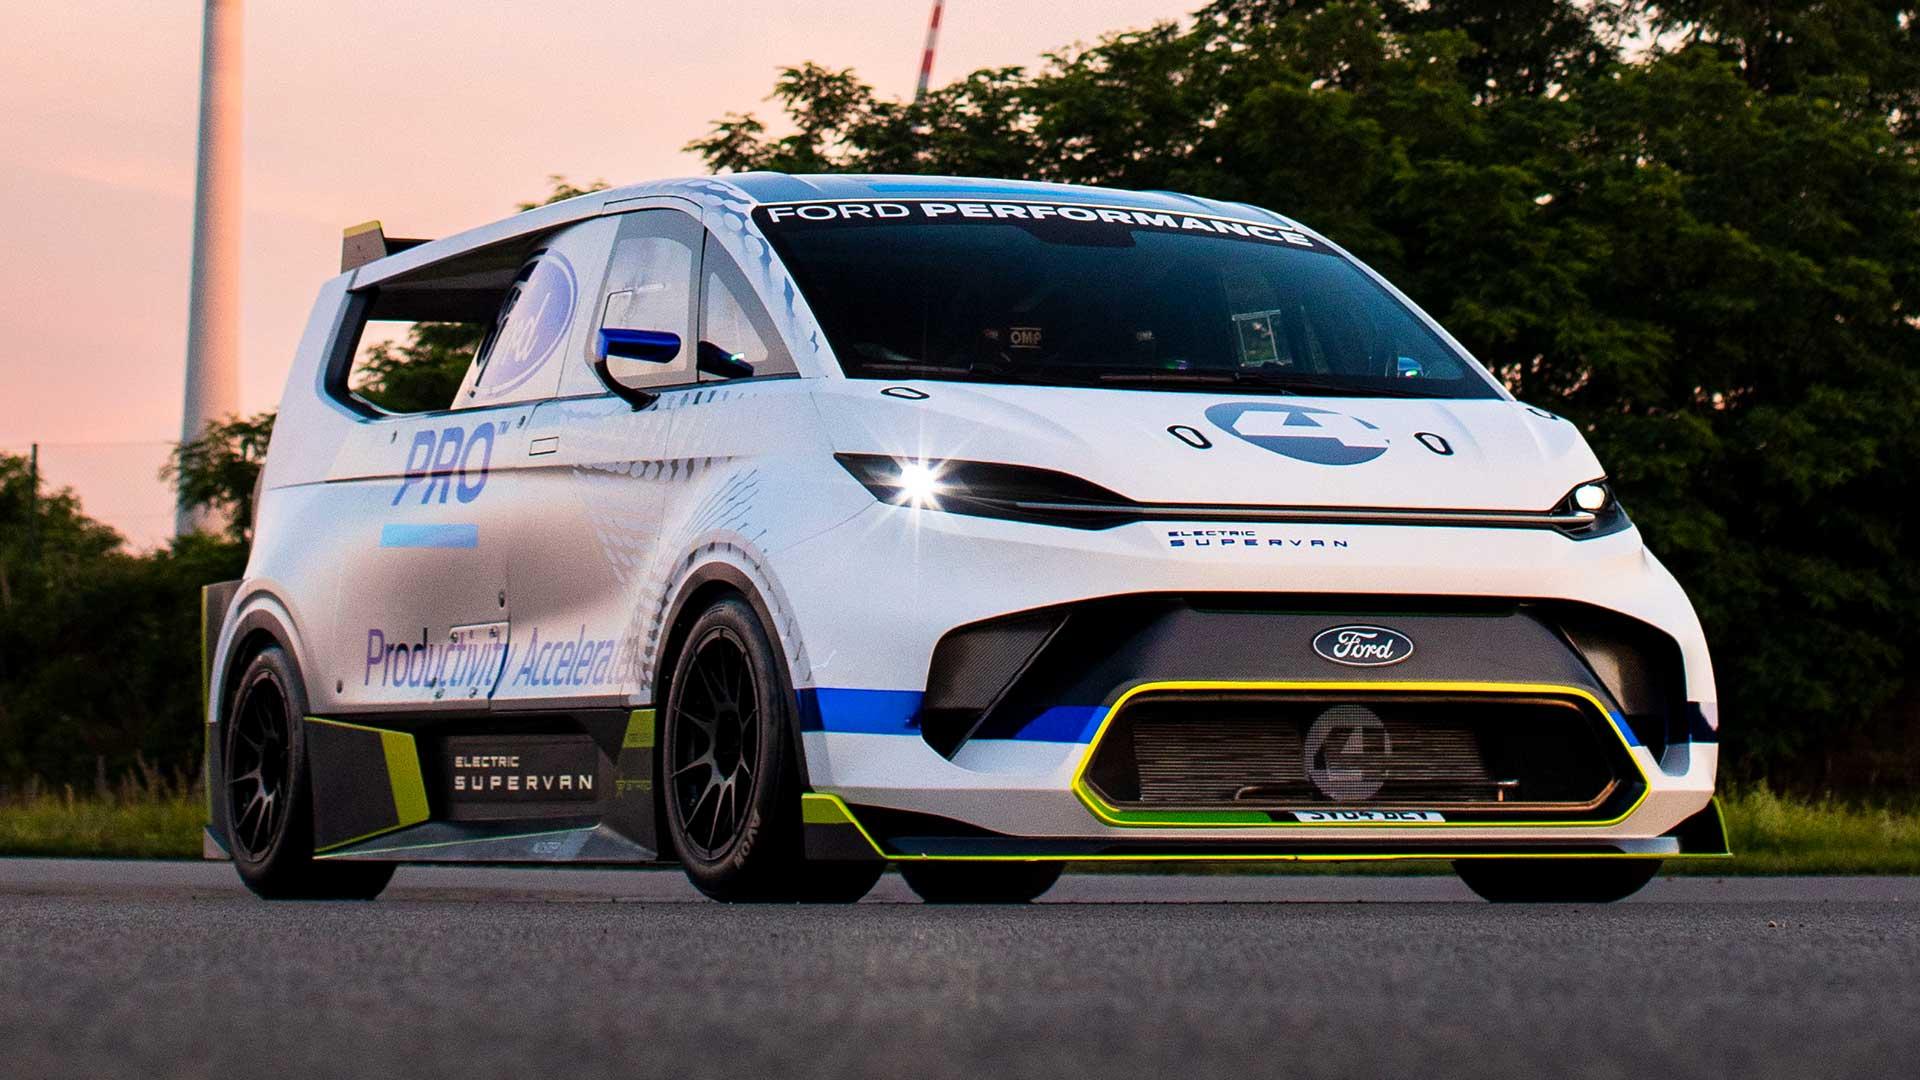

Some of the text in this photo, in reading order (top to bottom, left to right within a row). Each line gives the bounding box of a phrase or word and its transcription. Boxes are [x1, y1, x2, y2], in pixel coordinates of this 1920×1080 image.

[767, 203, 1314, 247] FORD PERFORMANCE
[1010, 331, 1042, 345] OMP
[391, 422, 495, 506] PRO
[1170, 538, 1348, 548] SUPERVAN
[1333, 631, 1394, 660] Ford
[364, 627, 518, 697] Productivity
[455, 756, 520, 768] ELECTRIC
[455, 774, 593, 790] SUPERVAN
